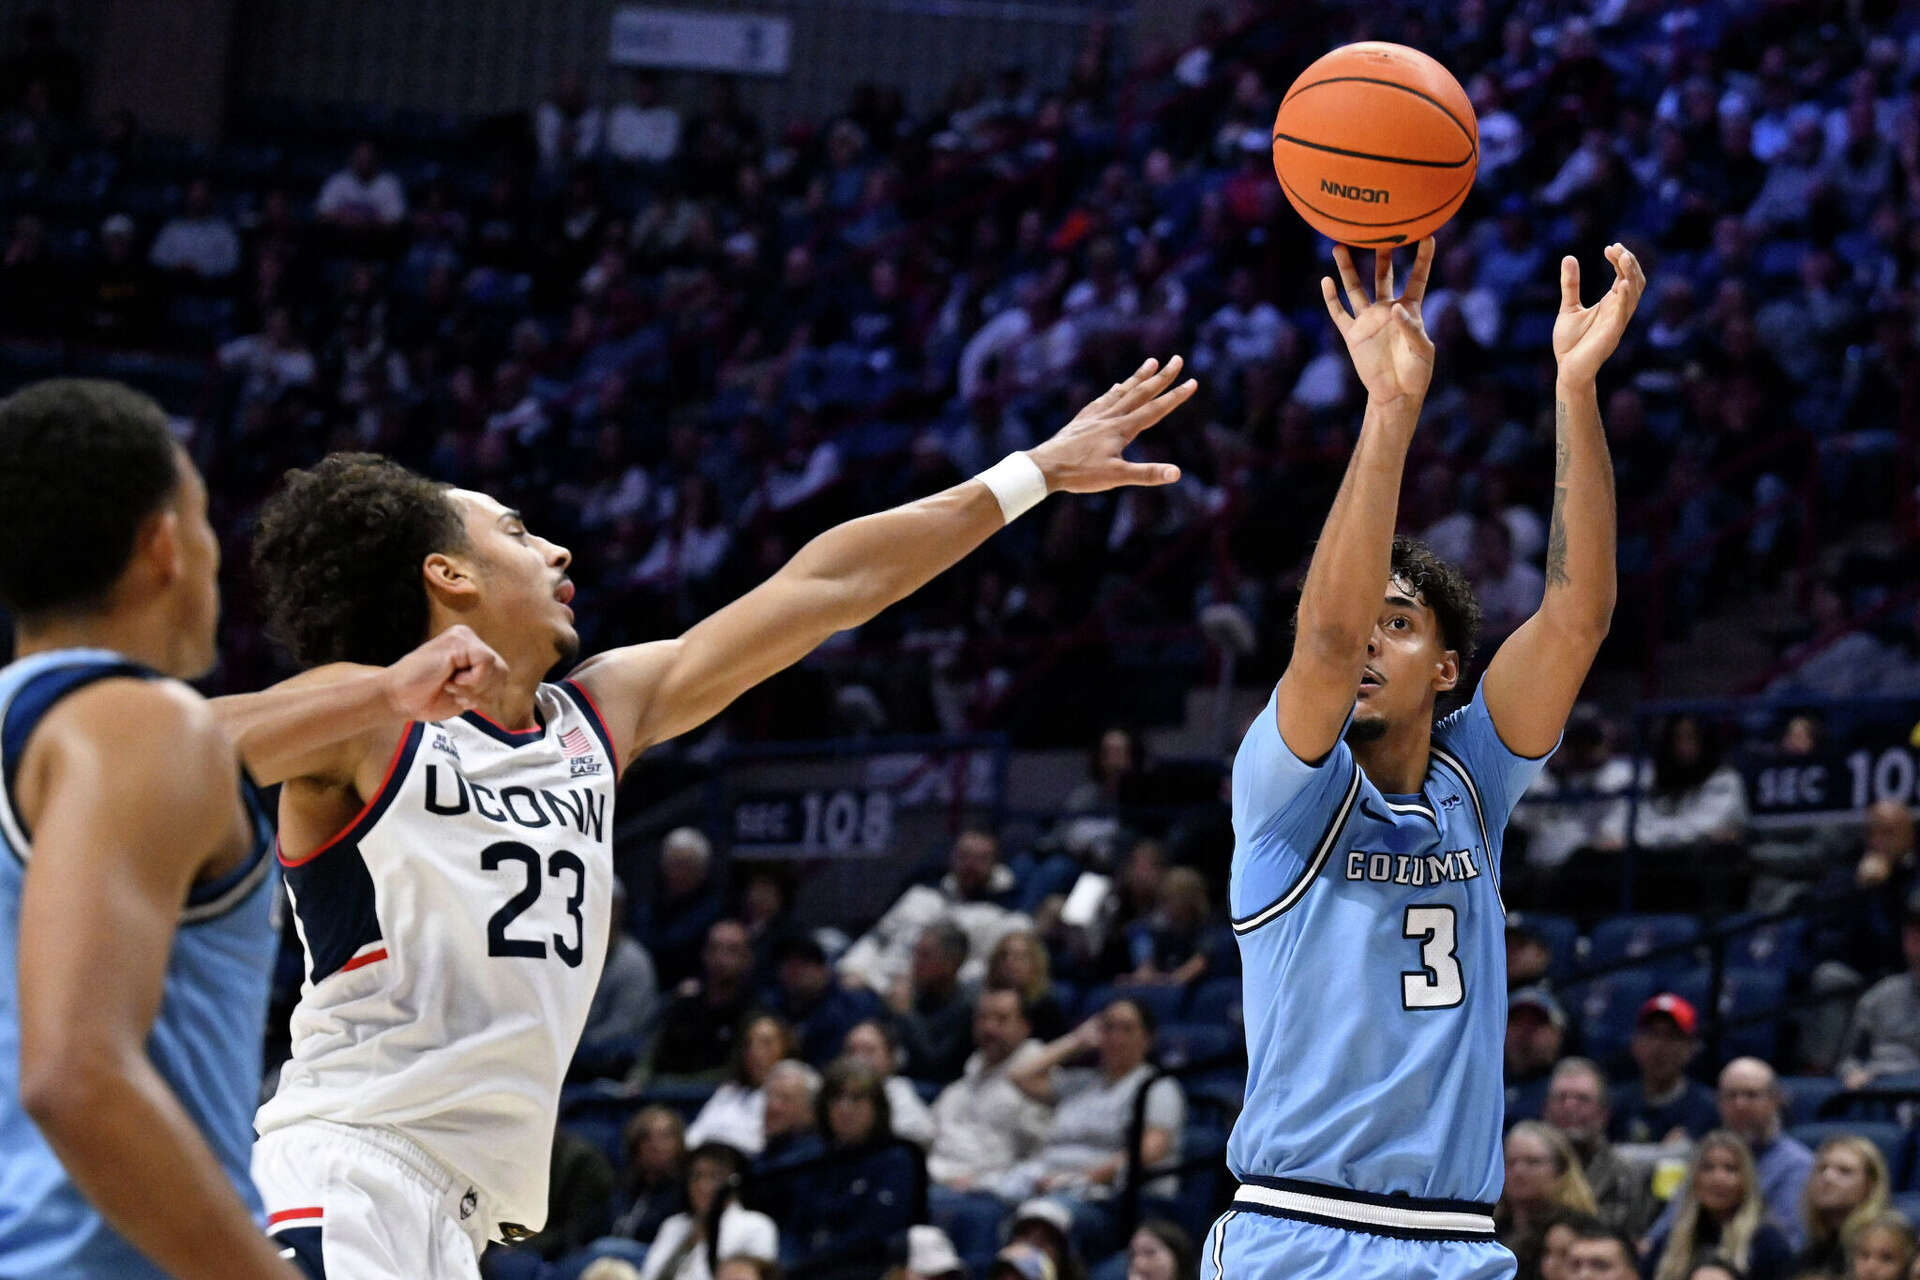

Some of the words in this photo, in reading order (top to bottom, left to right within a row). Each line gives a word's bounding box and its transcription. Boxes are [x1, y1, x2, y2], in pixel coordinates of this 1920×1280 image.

[1320, 178, 1390, 204] UCONN
[570, 754, 594, 765] BIG
[570, 763, 602, 775] EAST
[1758, 765, 1827, 807] SEC
[1847, 748, 1920, 812] 10
[425, 764, 605, 843] UCONN
[481, 840, 585, 968] 23
[1401, 903, 1467, 1012] 3
